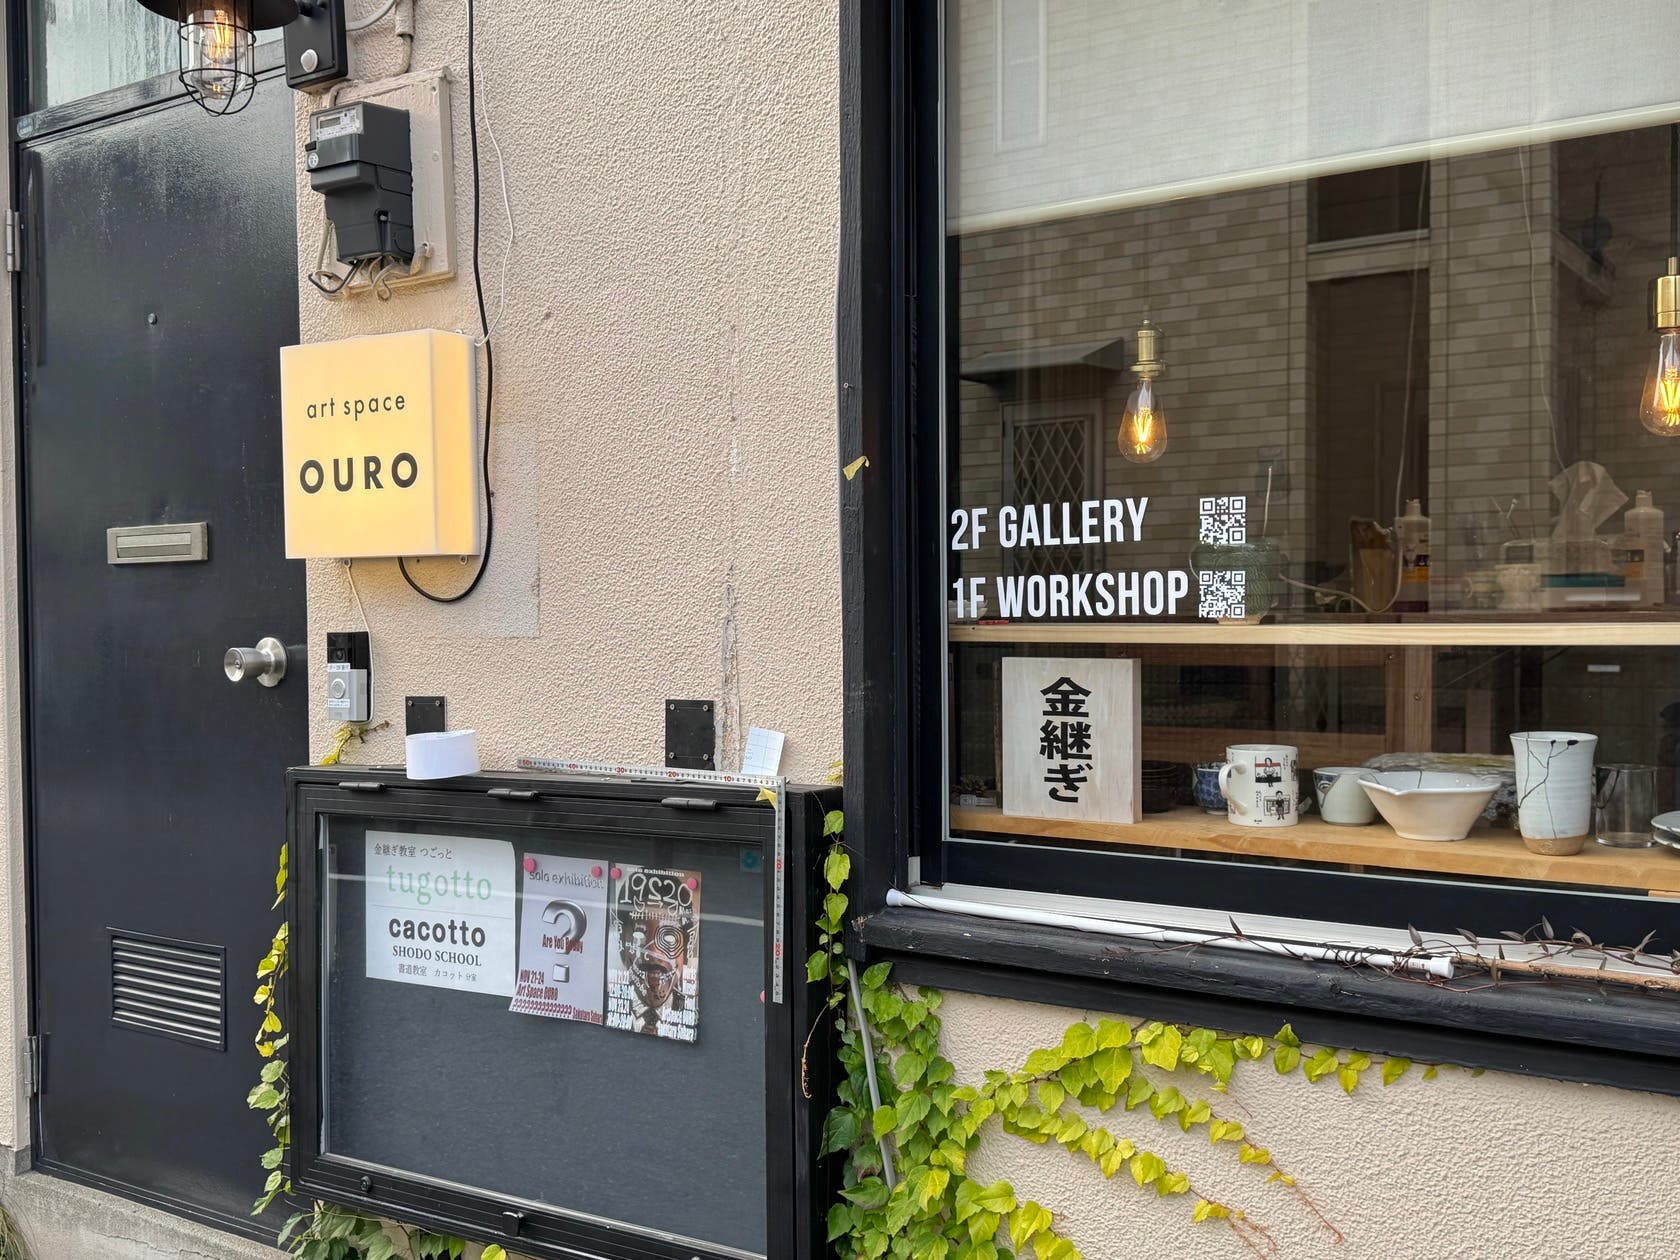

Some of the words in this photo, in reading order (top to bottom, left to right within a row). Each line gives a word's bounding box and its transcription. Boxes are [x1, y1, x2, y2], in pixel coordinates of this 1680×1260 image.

[307, 397, 335, 419] art
[343, 395, 406, 422] space
[299, 452, 418, 494] OURO
[951, 507, 988, 550] 2F
[999, 497, 1149, 549] GALLERY
[953, 577, 986, 618] 1F
[996, 570, 1189, 618] WORKSHOP
[1039, 676, 1094, 803] 金継ぎ
[374, 842, 417, 858] 金継ぎ教室
[386, 865, 492, 906] tugotto
[529, 869, 550, 882] solo
[388, 918, 486, 948] cacotto
[542, 933, 553, 949] Are
[554, 935, 565, 950] You
[392, 945, 432, 961] SHODO
[434, 950, 482, 967] SCHOOL
[516, 983, 526, 997] Art
